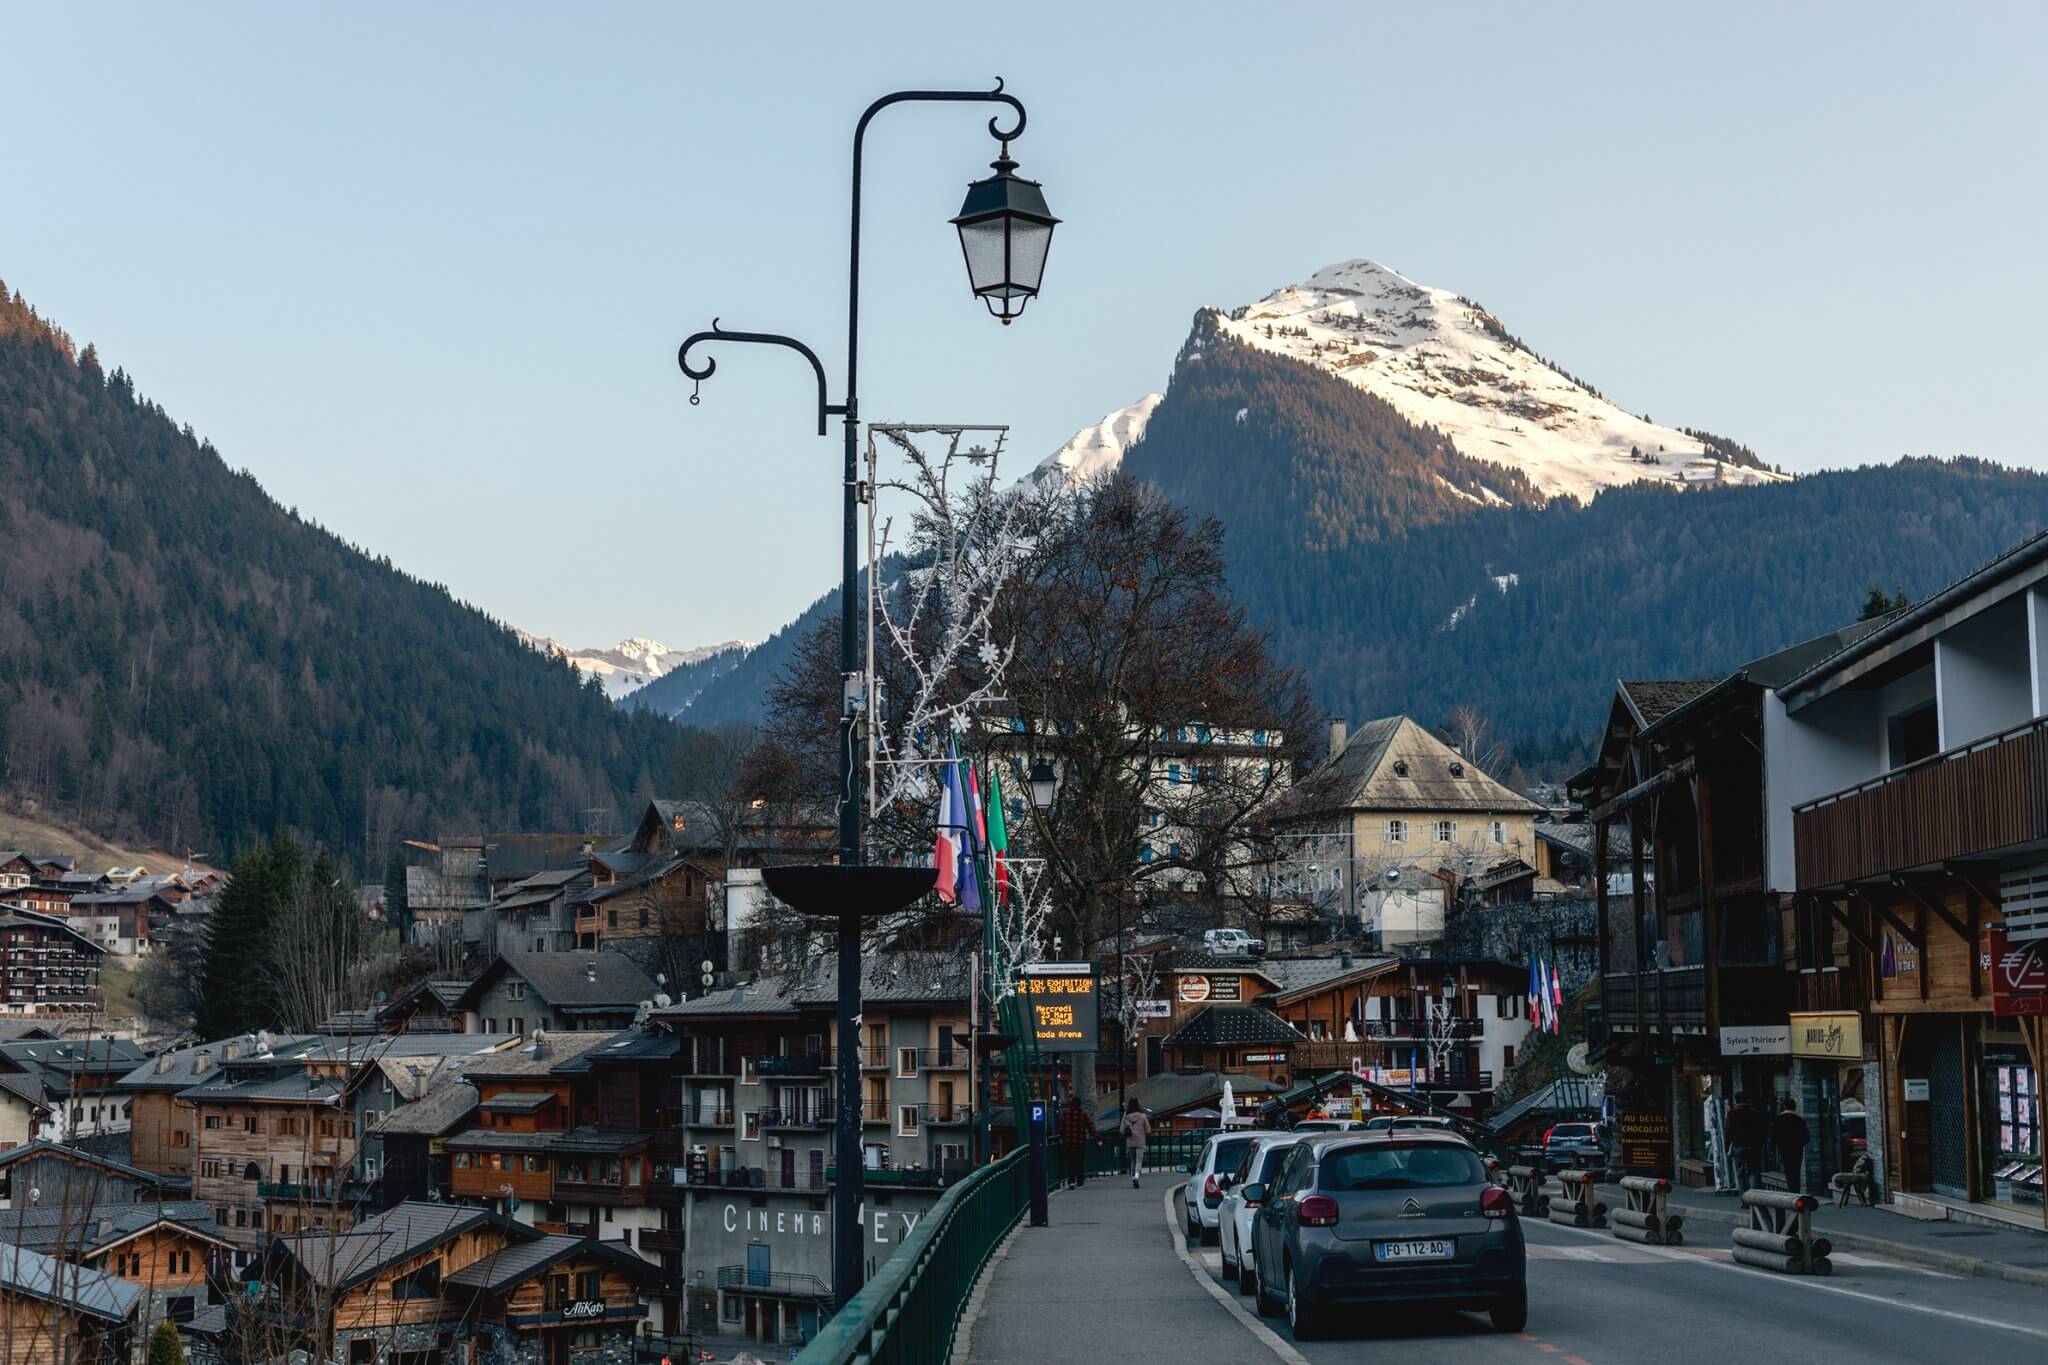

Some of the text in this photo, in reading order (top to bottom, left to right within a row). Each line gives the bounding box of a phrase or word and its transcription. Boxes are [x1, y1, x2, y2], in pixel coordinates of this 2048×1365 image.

[1019, 979, 1092, 987] MTCH EXHIBITION
[1036, 1005, 1072, 1013] Mercredi
[1726, 1035, 1776, 1045] Sylvie Thiriez
[1033, 1106, 1042, 1121] P
[724, 1204, 821, 1235] CINEMA
[563, 1301, 604, 1317] AliKats
